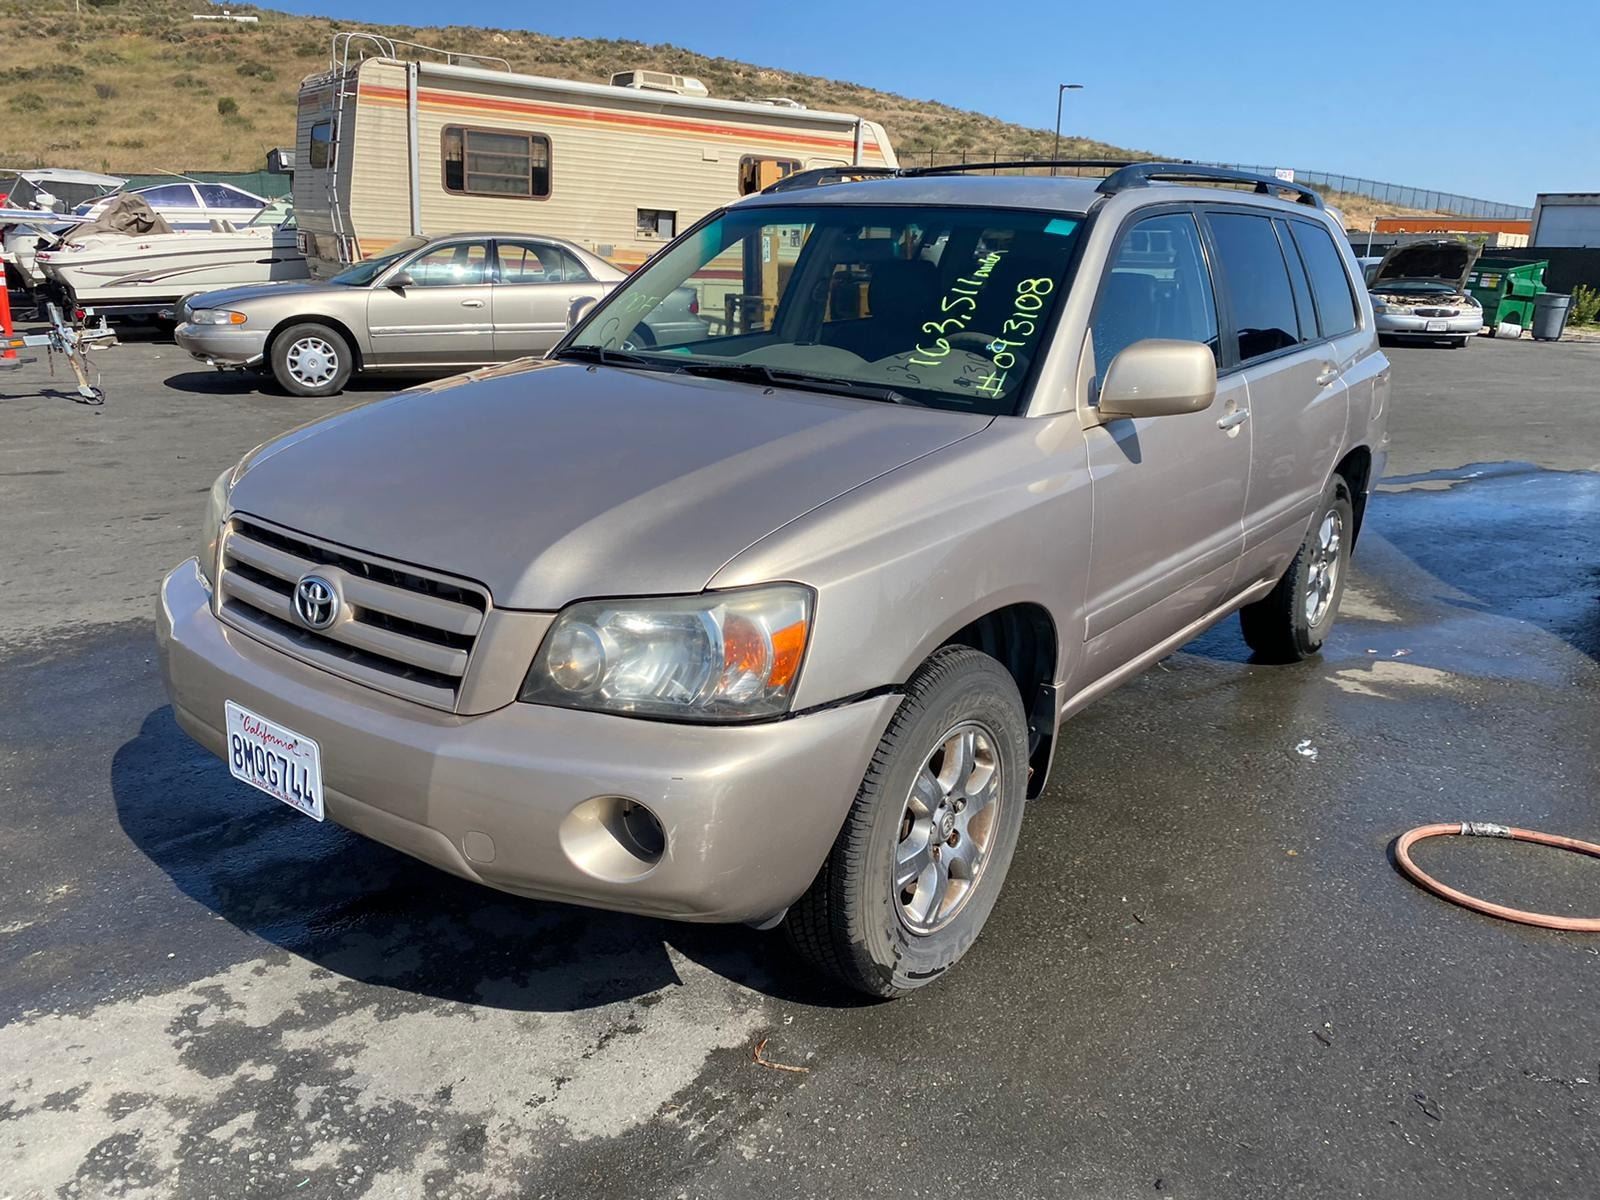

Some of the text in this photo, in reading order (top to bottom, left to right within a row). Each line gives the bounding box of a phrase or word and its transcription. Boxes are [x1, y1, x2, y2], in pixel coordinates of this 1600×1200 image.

[909, 277, 983, 366] 163,511
[975, 277, 1054, 397] #093108
[232, 733, 314, 807] 8MQG744
[243, 715, 295, 751] California
